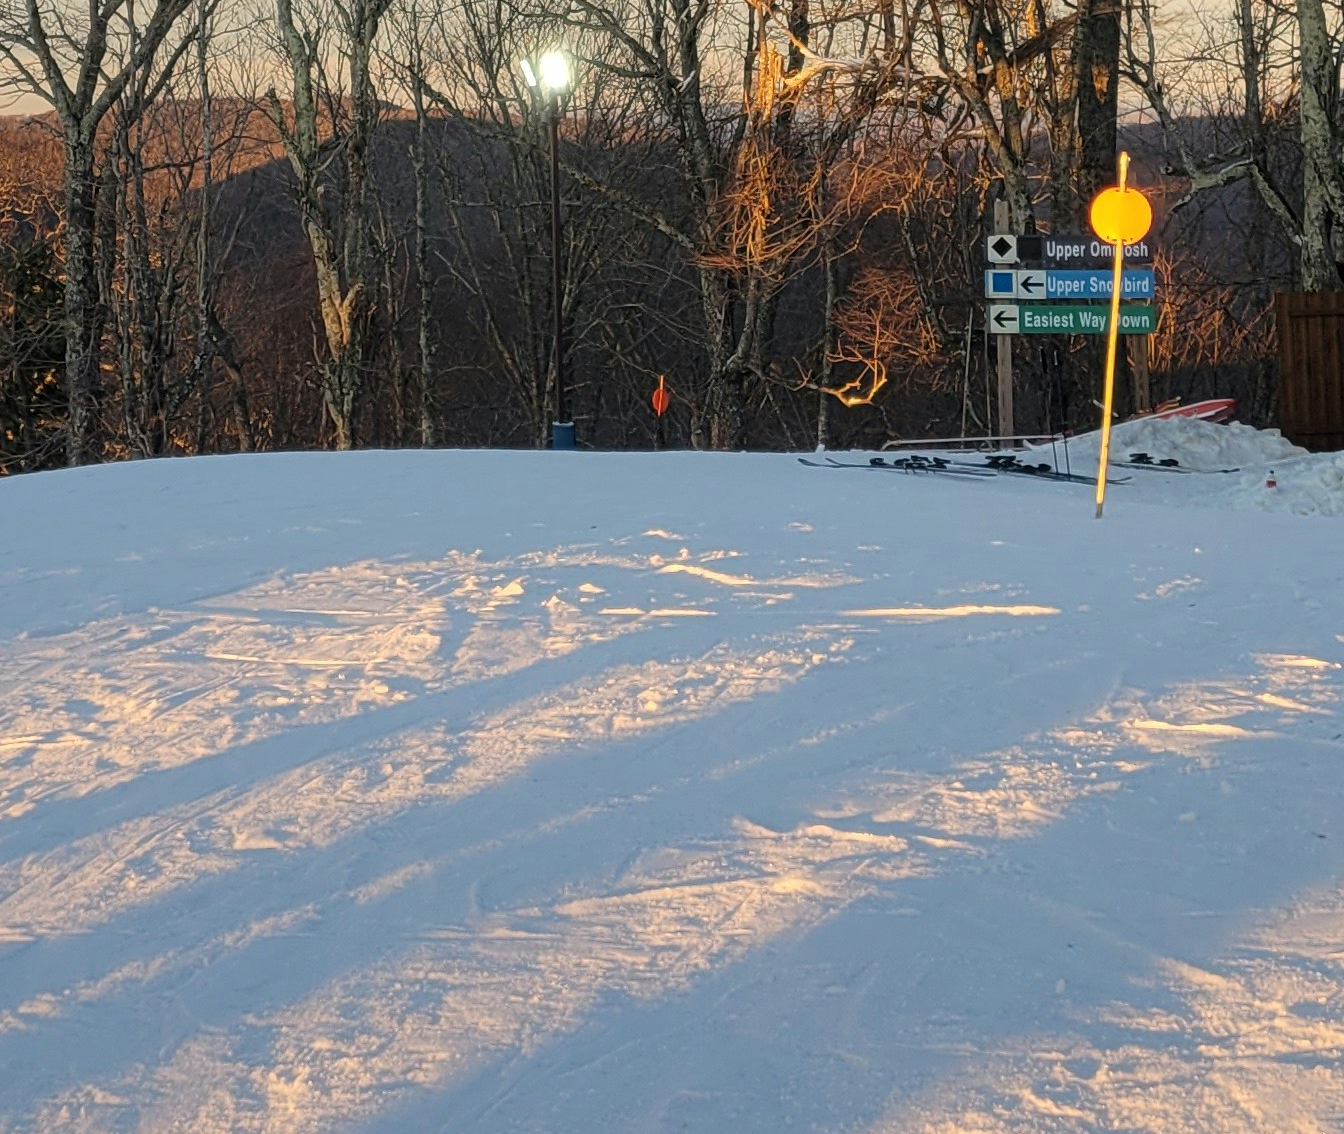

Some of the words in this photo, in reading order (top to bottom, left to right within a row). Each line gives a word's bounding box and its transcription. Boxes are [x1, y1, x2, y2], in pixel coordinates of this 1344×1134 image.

[1046, 240, 1086, 261] Upper
[1090, 241, 1149, 260] Omiosh
[1047, 276, 1086, 297] Upper
[1089, 276, 1149, 293] Snobird
[1024, 311, 1074, 328] Easiest
[1079, 311, 1106, 332] Way
